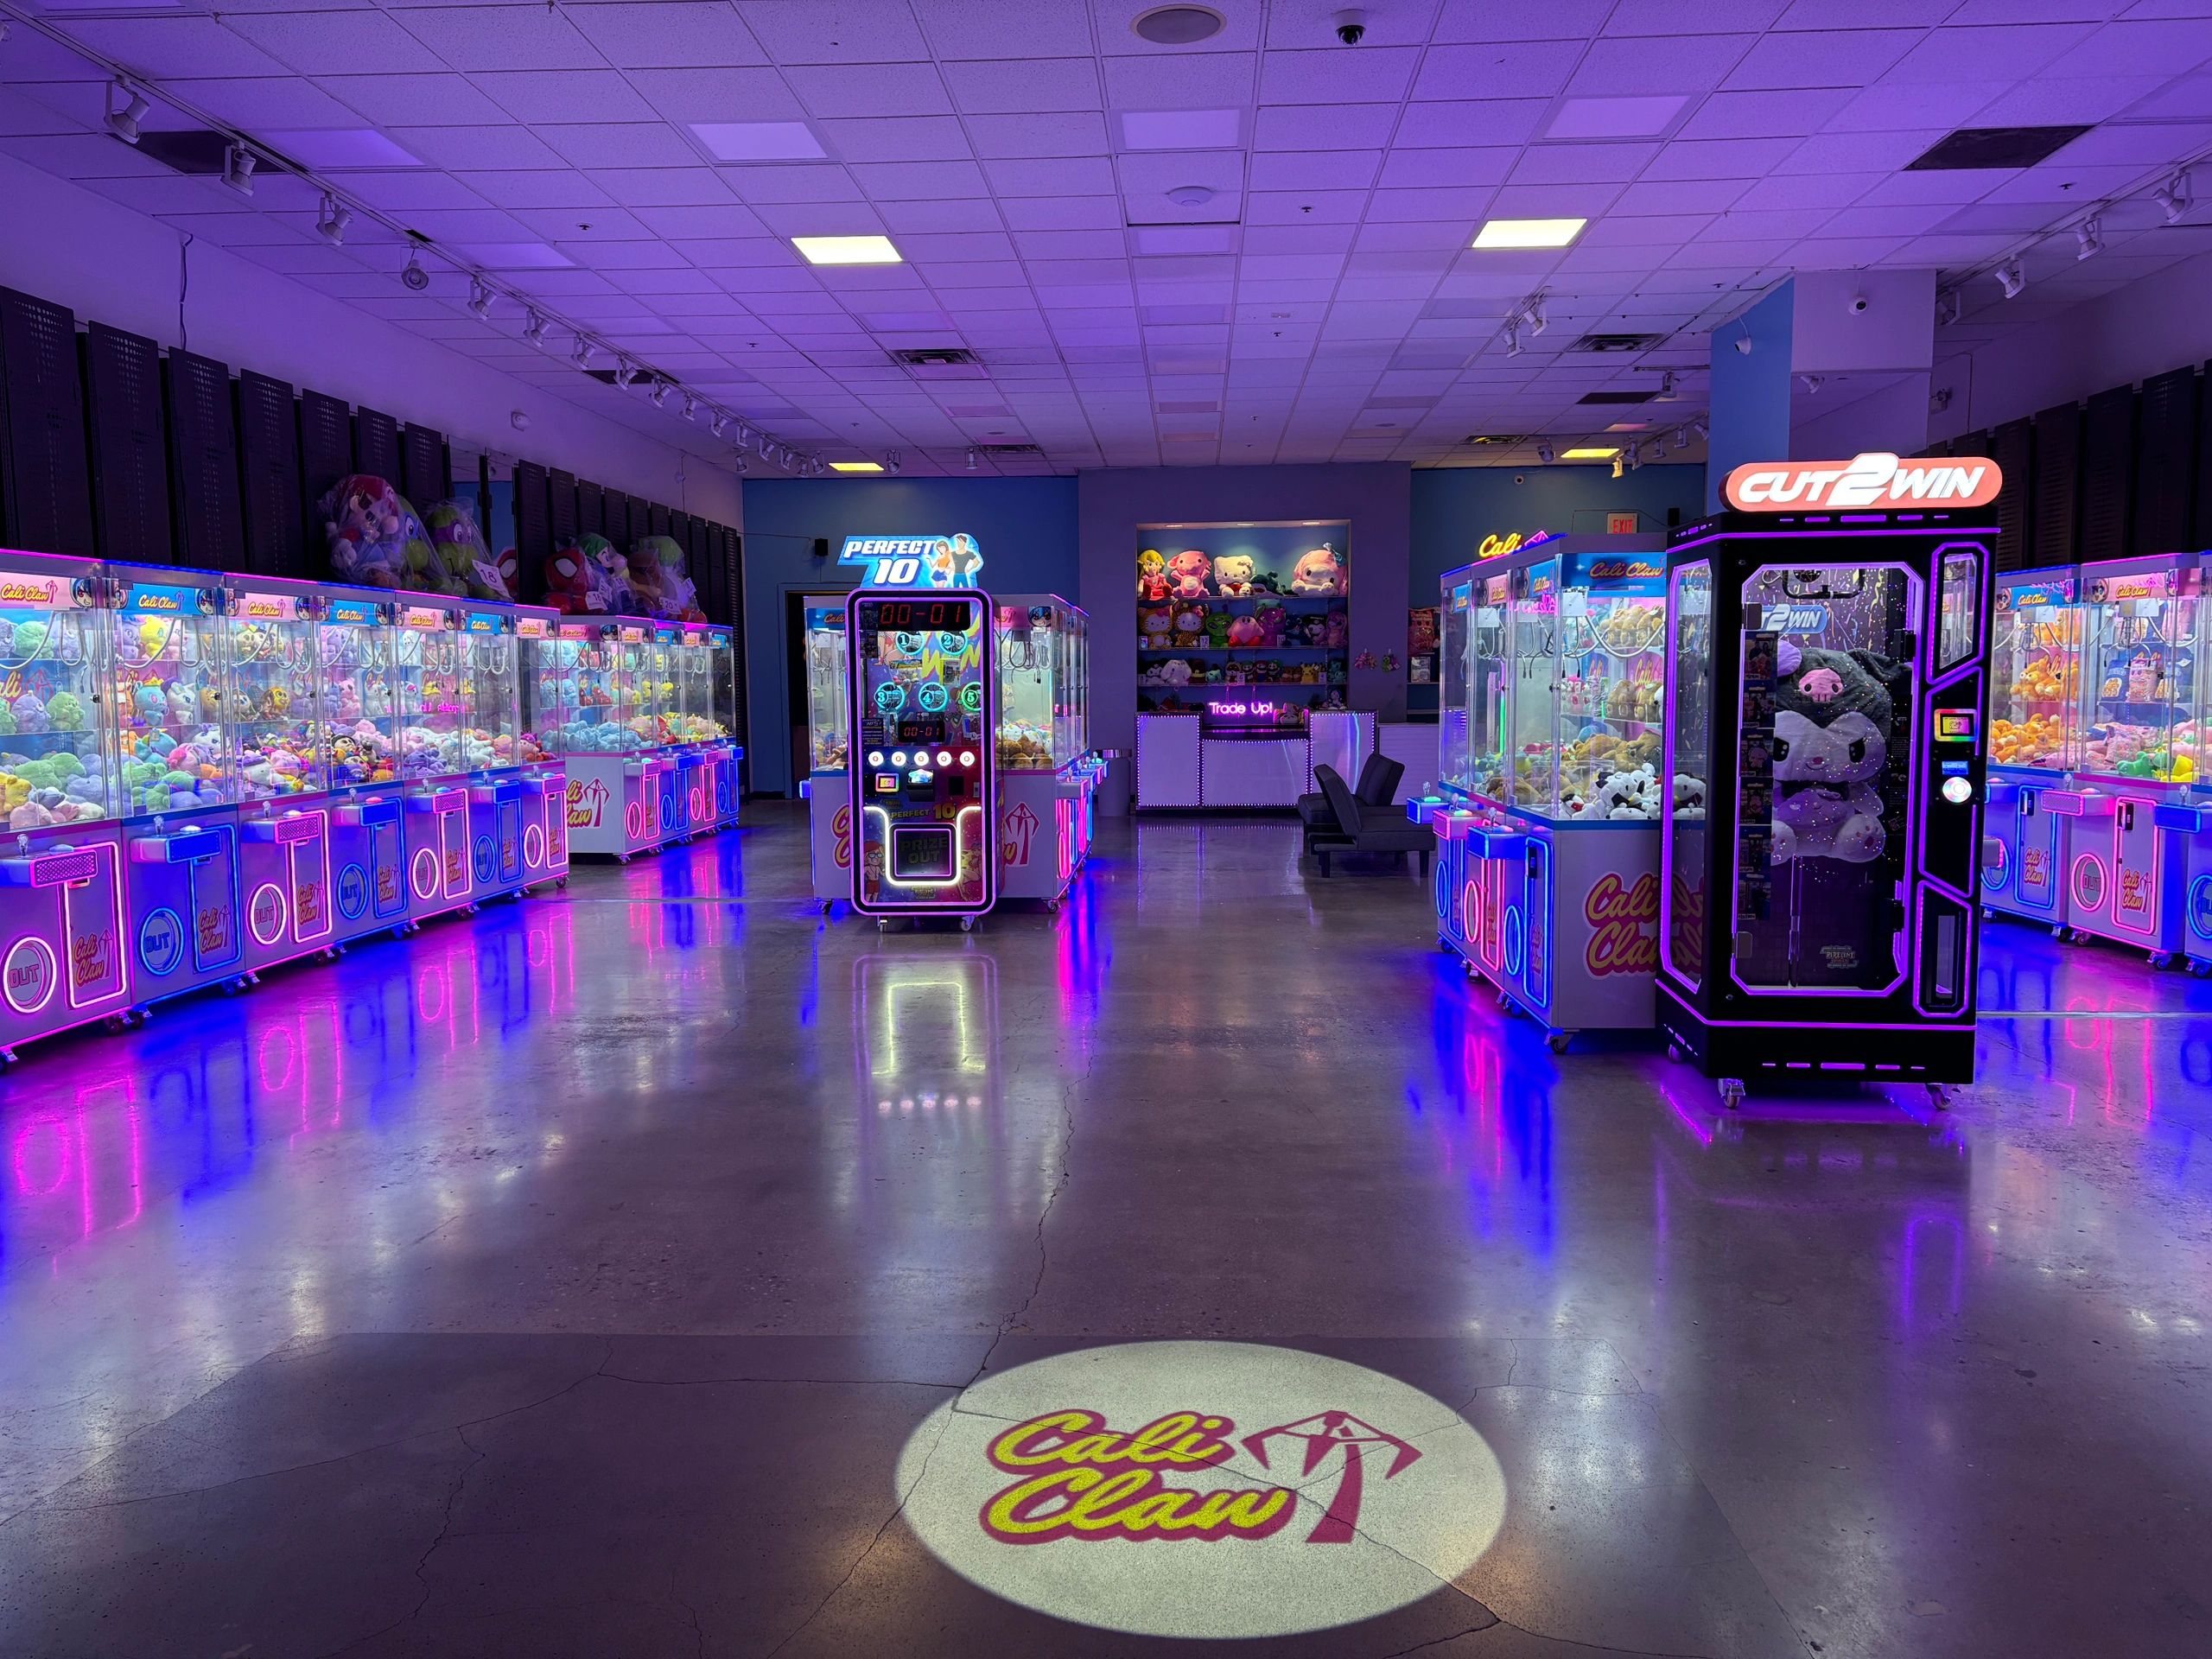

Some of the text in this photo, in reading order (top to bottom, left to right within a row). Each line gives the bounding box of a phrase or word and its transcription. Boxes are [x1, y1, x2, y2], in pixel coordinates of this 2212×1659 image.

[1738, 452, 1986, 506] CUT2WIN
[1612, 518, 1633, 534] EXIT
[843, 540, 937, 558] PERFECT
[1478, 532, 1522, 558] Cali
[873, 558, 920, 584] 10
[1589, 562, 1664, 579] Cali Claw
[1, 583, 49, 602] Cali Claw
[138, 594, 178, 610] Cali Claw
[1761, 604, 1821, 631] T2WIN
[899, 634, 908, 645] 1
[943, 634, 952, 645] 2
[877, 691, 887, 702] 3
[922, 691, 931, 703] 4
[967, 691, 976, 702] 5
[1209, 702, 1273, 716] Trade Up!
[567, 803, 593, 826] law
[890, 801, 957, 820] PERFECT 10
[899, 836, 948, 852] PRIZE
[908, 849, 941, 864] OUT
[1586, 874, 1658, 923] Cali
[74, 933, 99, 963] Cali
[143, 932, 170, 954] OUT
[8, 963, 40, 988] OUT
[75, 960, 105, 987] Claw
[988, 1409, 1236, 1471] Cali
[982, 1469, 1294, 1543] Claw
